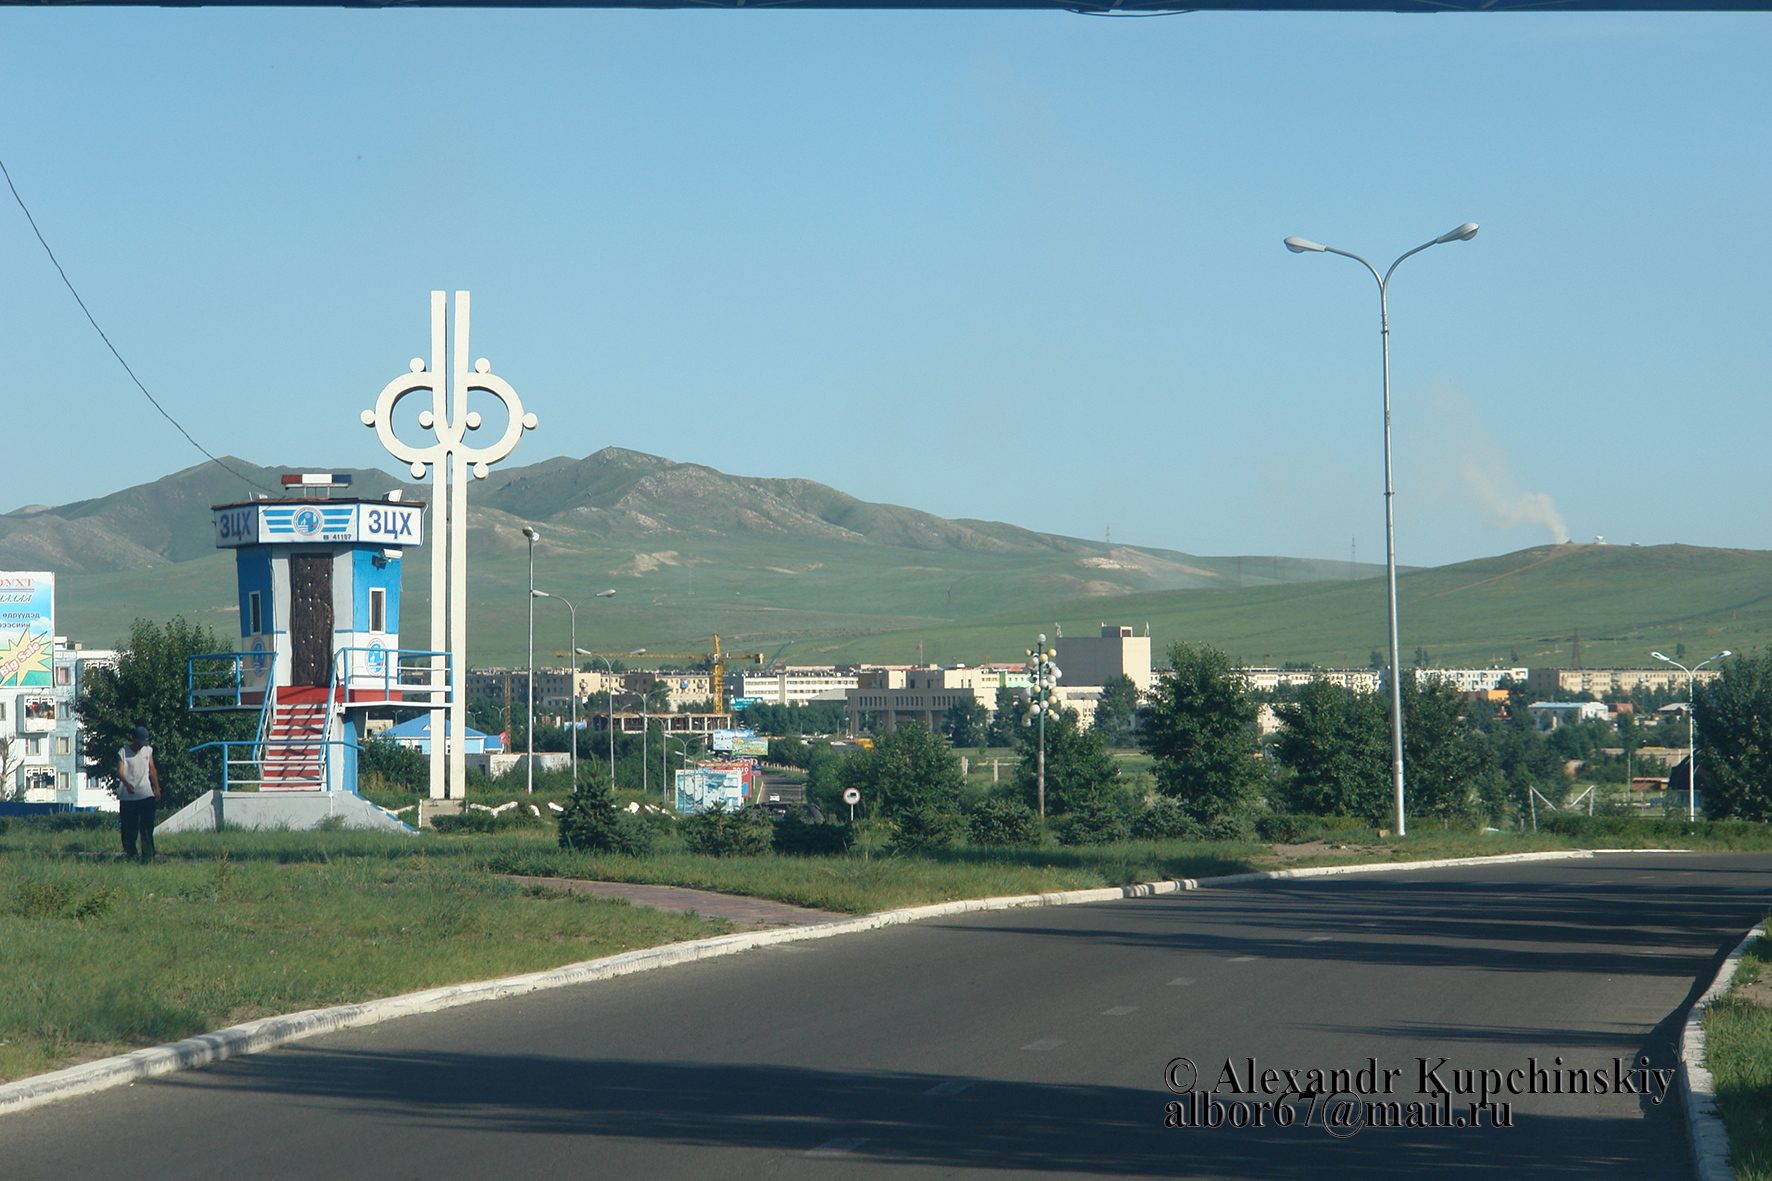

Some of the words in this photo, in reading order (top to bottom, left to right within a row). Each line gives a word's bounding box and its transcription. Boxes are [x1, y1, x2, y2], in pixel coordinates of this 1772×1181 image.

[220, 510, 252, 541] ЗЦХ
[368, 509, 412, 540] ЗЦХ
[0, 659, 20, 678] Big
[17, 642, 41, 663] Sale
